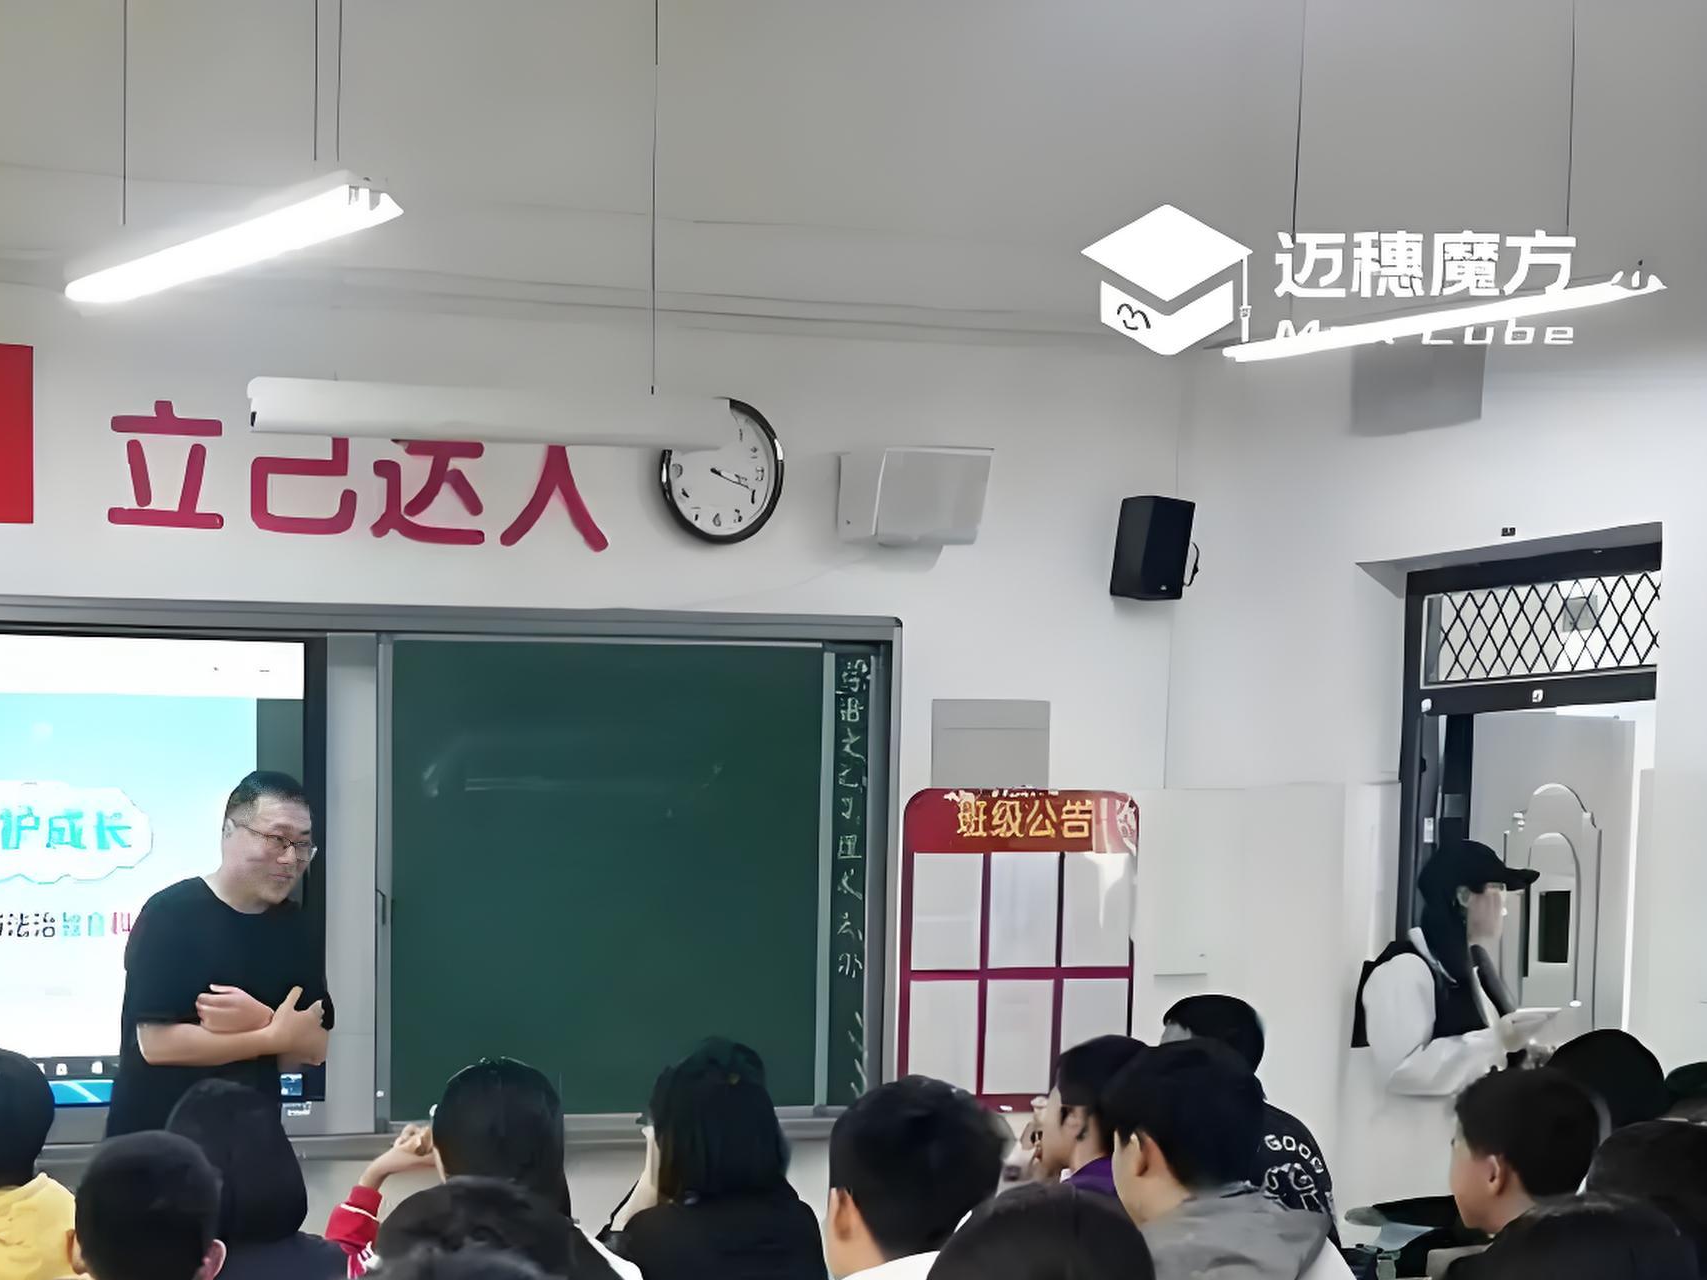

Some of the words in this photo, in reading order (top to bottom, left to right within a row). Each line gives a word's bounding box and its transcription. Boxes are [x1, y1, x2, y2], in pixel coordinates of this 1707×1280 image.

[107, 400, 610, 552] 立己达人
[957, 799, 1093, 838] 班级公告
